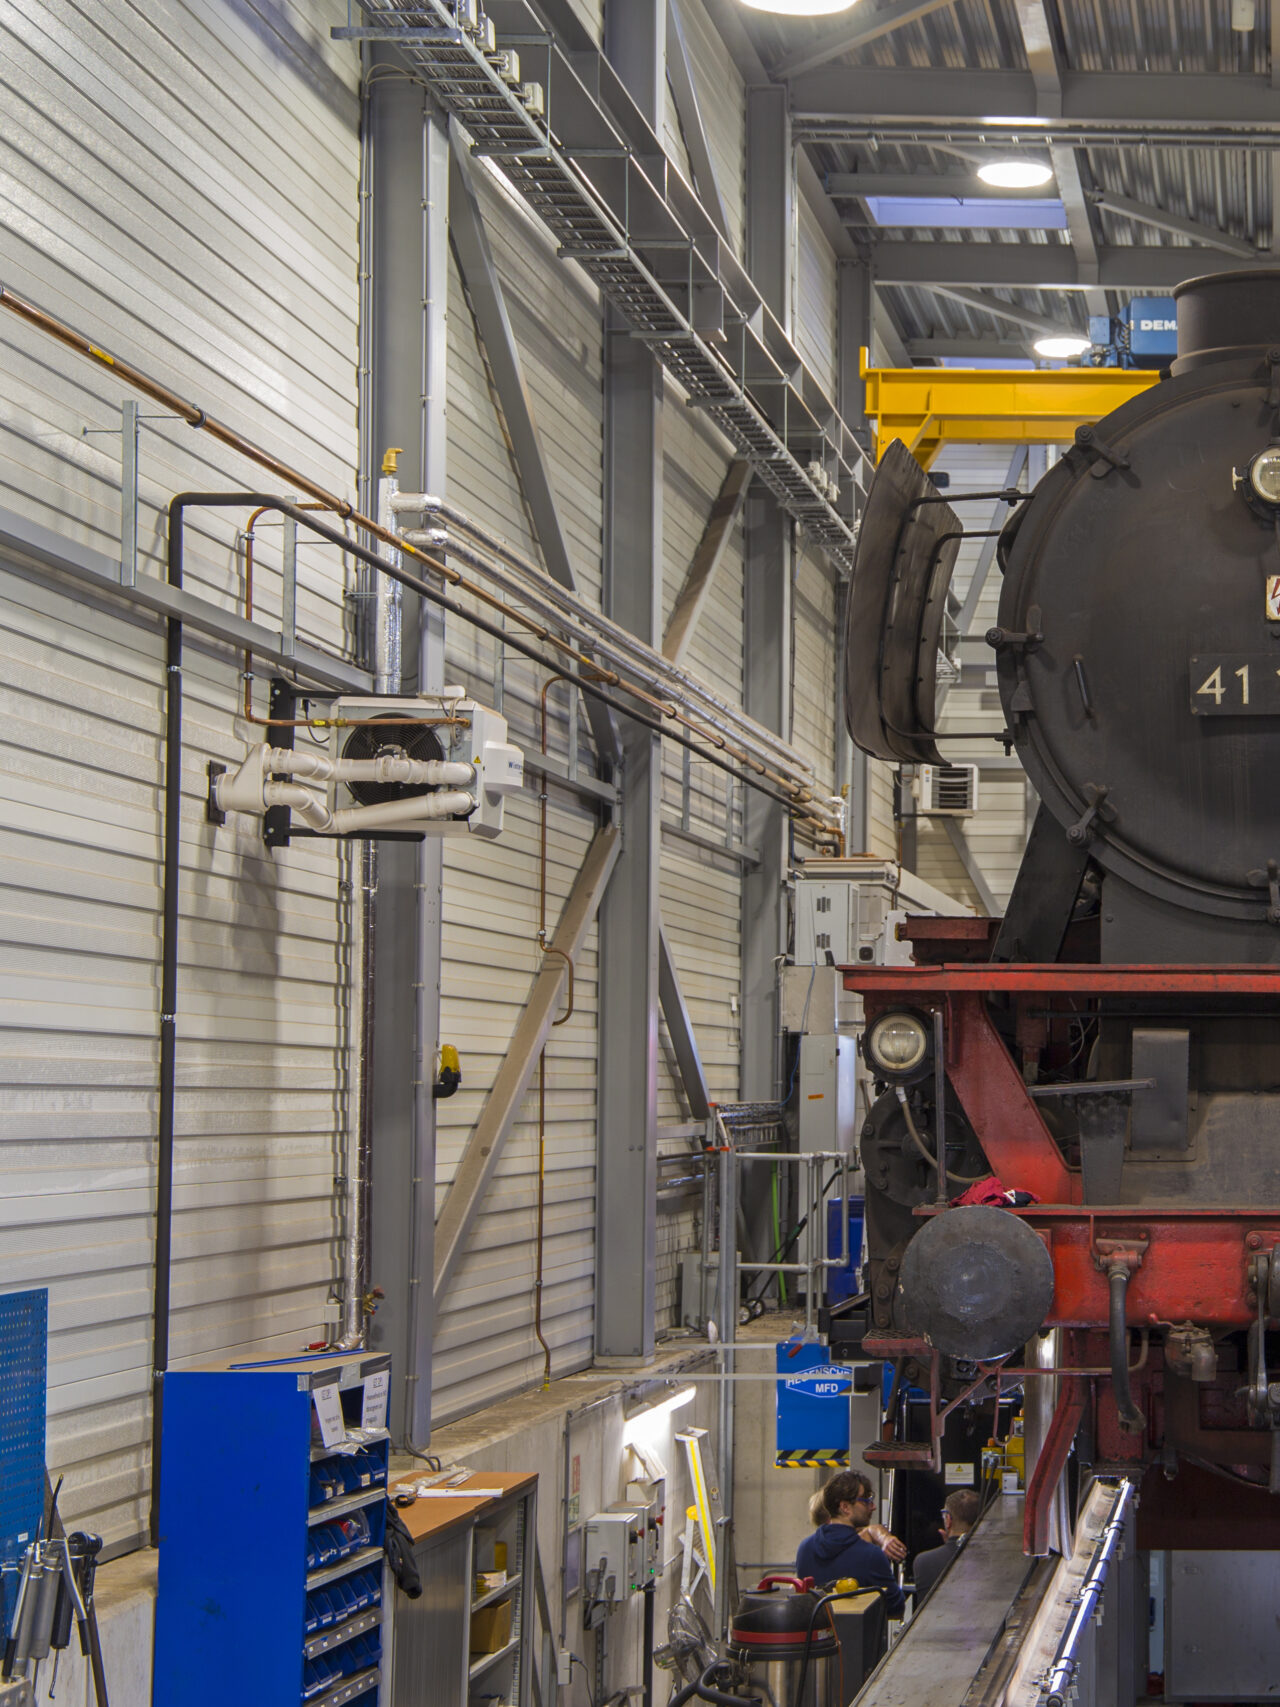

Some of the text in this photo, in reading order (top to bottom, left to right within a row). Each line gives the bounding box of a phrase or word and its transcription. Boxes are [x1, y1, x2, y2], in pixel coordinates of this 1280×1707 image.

[1140, 320, 1178, 331] DEM
[1196, 664, 1249, 705] 41
[815, 1383, 839, 1393] MFD
